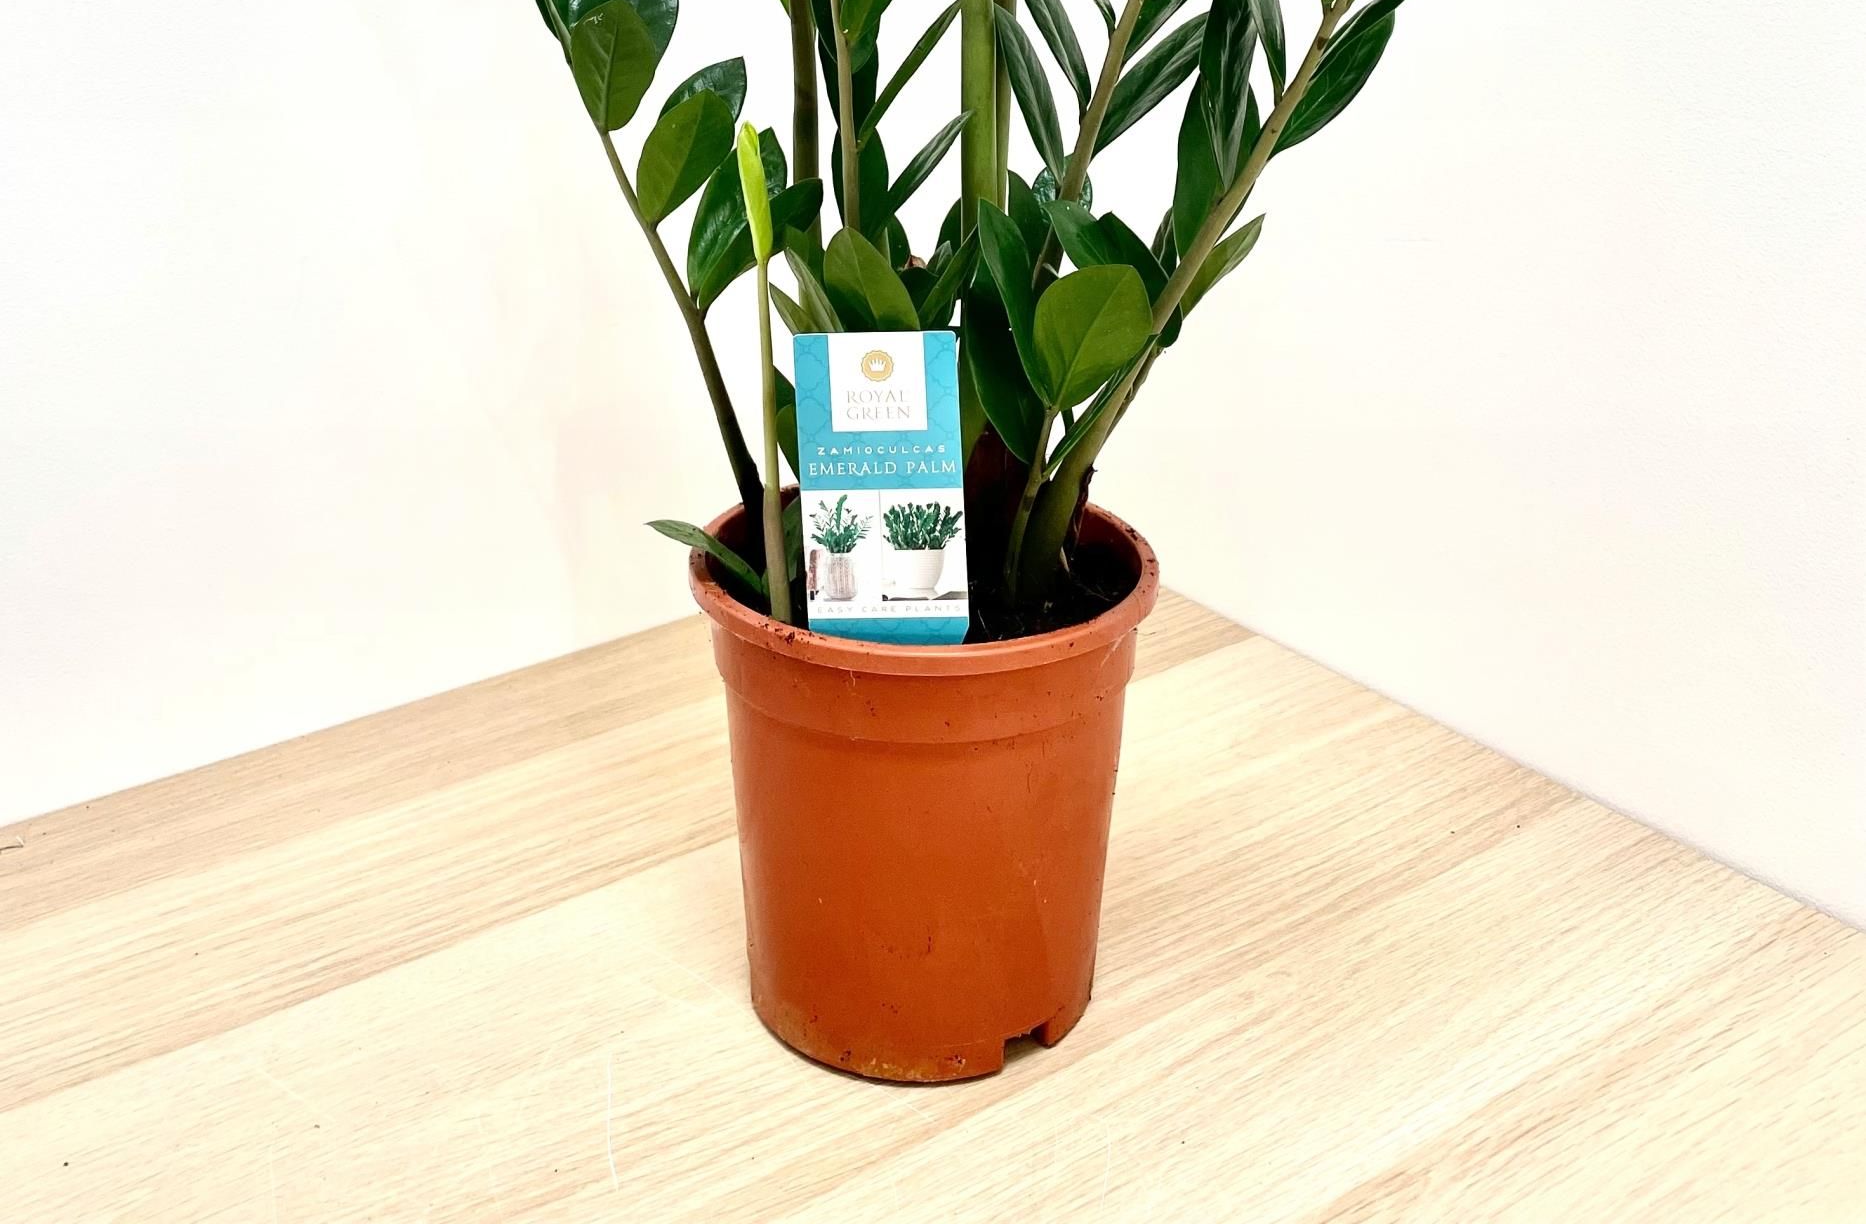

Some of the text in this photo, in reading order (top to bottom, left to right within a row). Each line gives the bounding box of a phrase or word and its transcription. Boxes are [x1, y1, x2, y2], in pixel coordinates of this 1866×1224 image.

[846, 389, 909, 404] ROYAL
[846, 406, 911, 421] GREEN
[817, 444, 946, 456] ZAMIOCULCAS
[808, 459, 957, 476] EMERALD PALM
[817, 604, 961, 614] EASY CARE PLANTS
